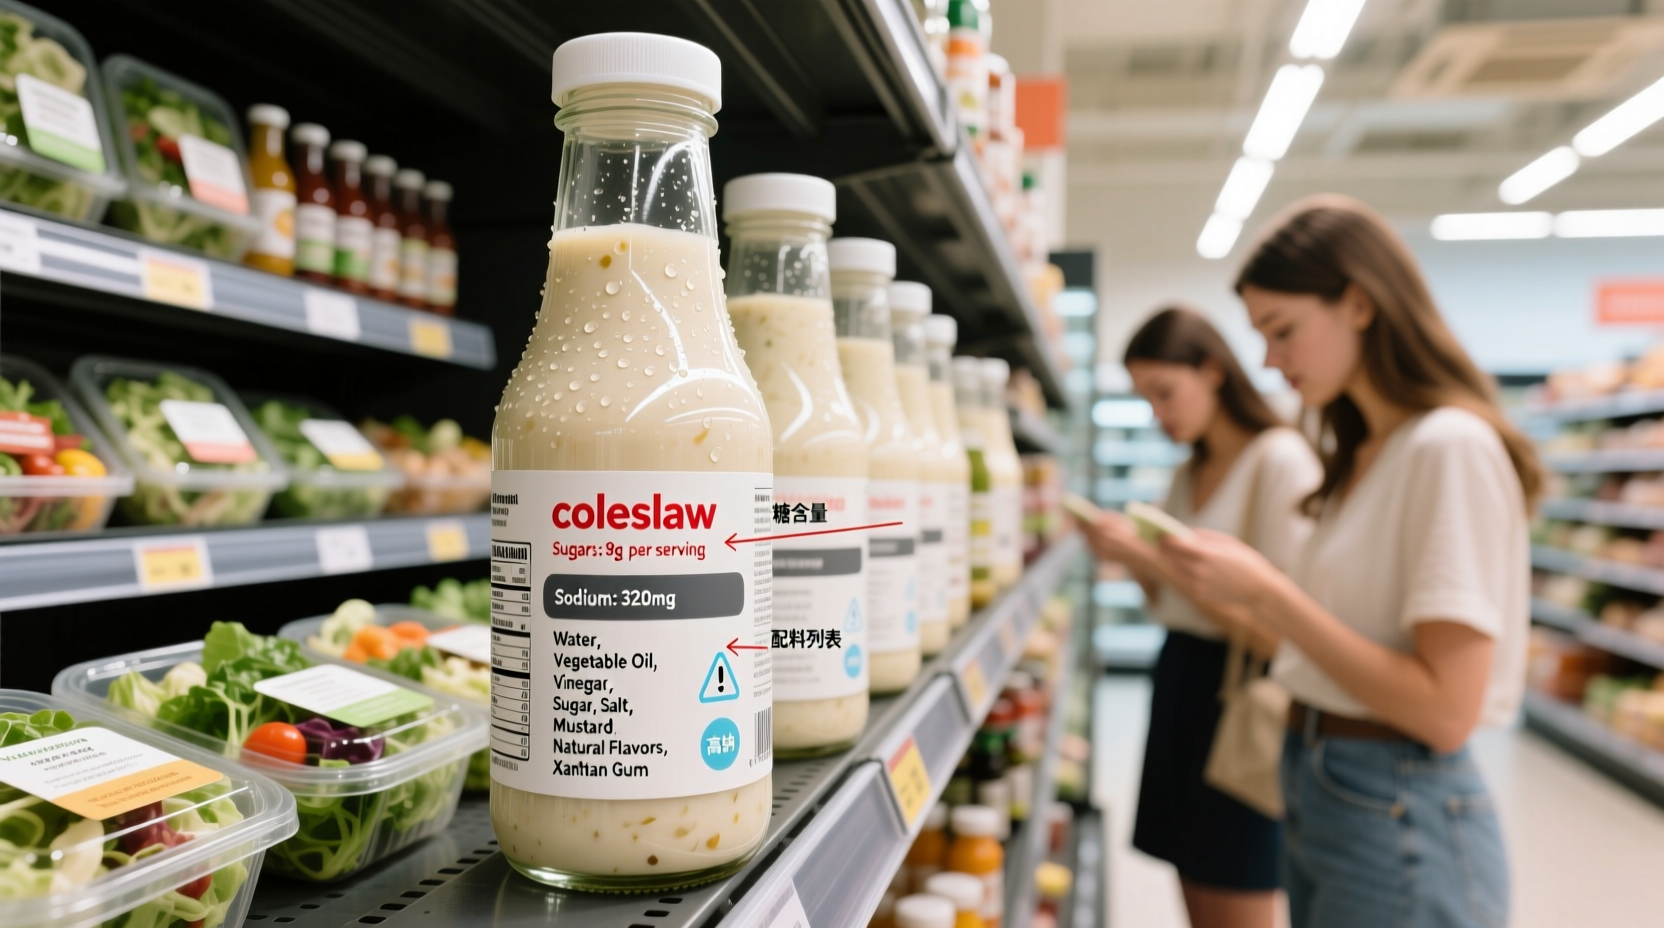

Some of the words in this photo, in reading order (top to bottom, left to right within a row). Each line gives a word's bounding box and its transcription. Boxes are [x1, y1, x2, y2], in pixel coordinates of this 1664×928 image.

[552, 493, 717, 530] coleslaw
[552, 541, 602, 561] Sugars:
[605, 541, 623, 562] 9g
[629, 545, 652, 561] per
[655, 543, 705, 561] serving
[555, 588, 617, 606] Sodium:
[622, 590, 675, 610] 320mg
[553, 631, 600, 650] Water,
[554, 653, 627, 672] Vegetable
[632, 653, 657, 672] Oil,
[554, 674, 613, 695] Vinegar,
[553, 696, 596, 716] Sugar,
[601, 697, 633, 716] Salt,
[554, 738, 604, 755] Natural
[610, 740, 667, 756] Flavors,
[613, 762, 648, 777] Gum
